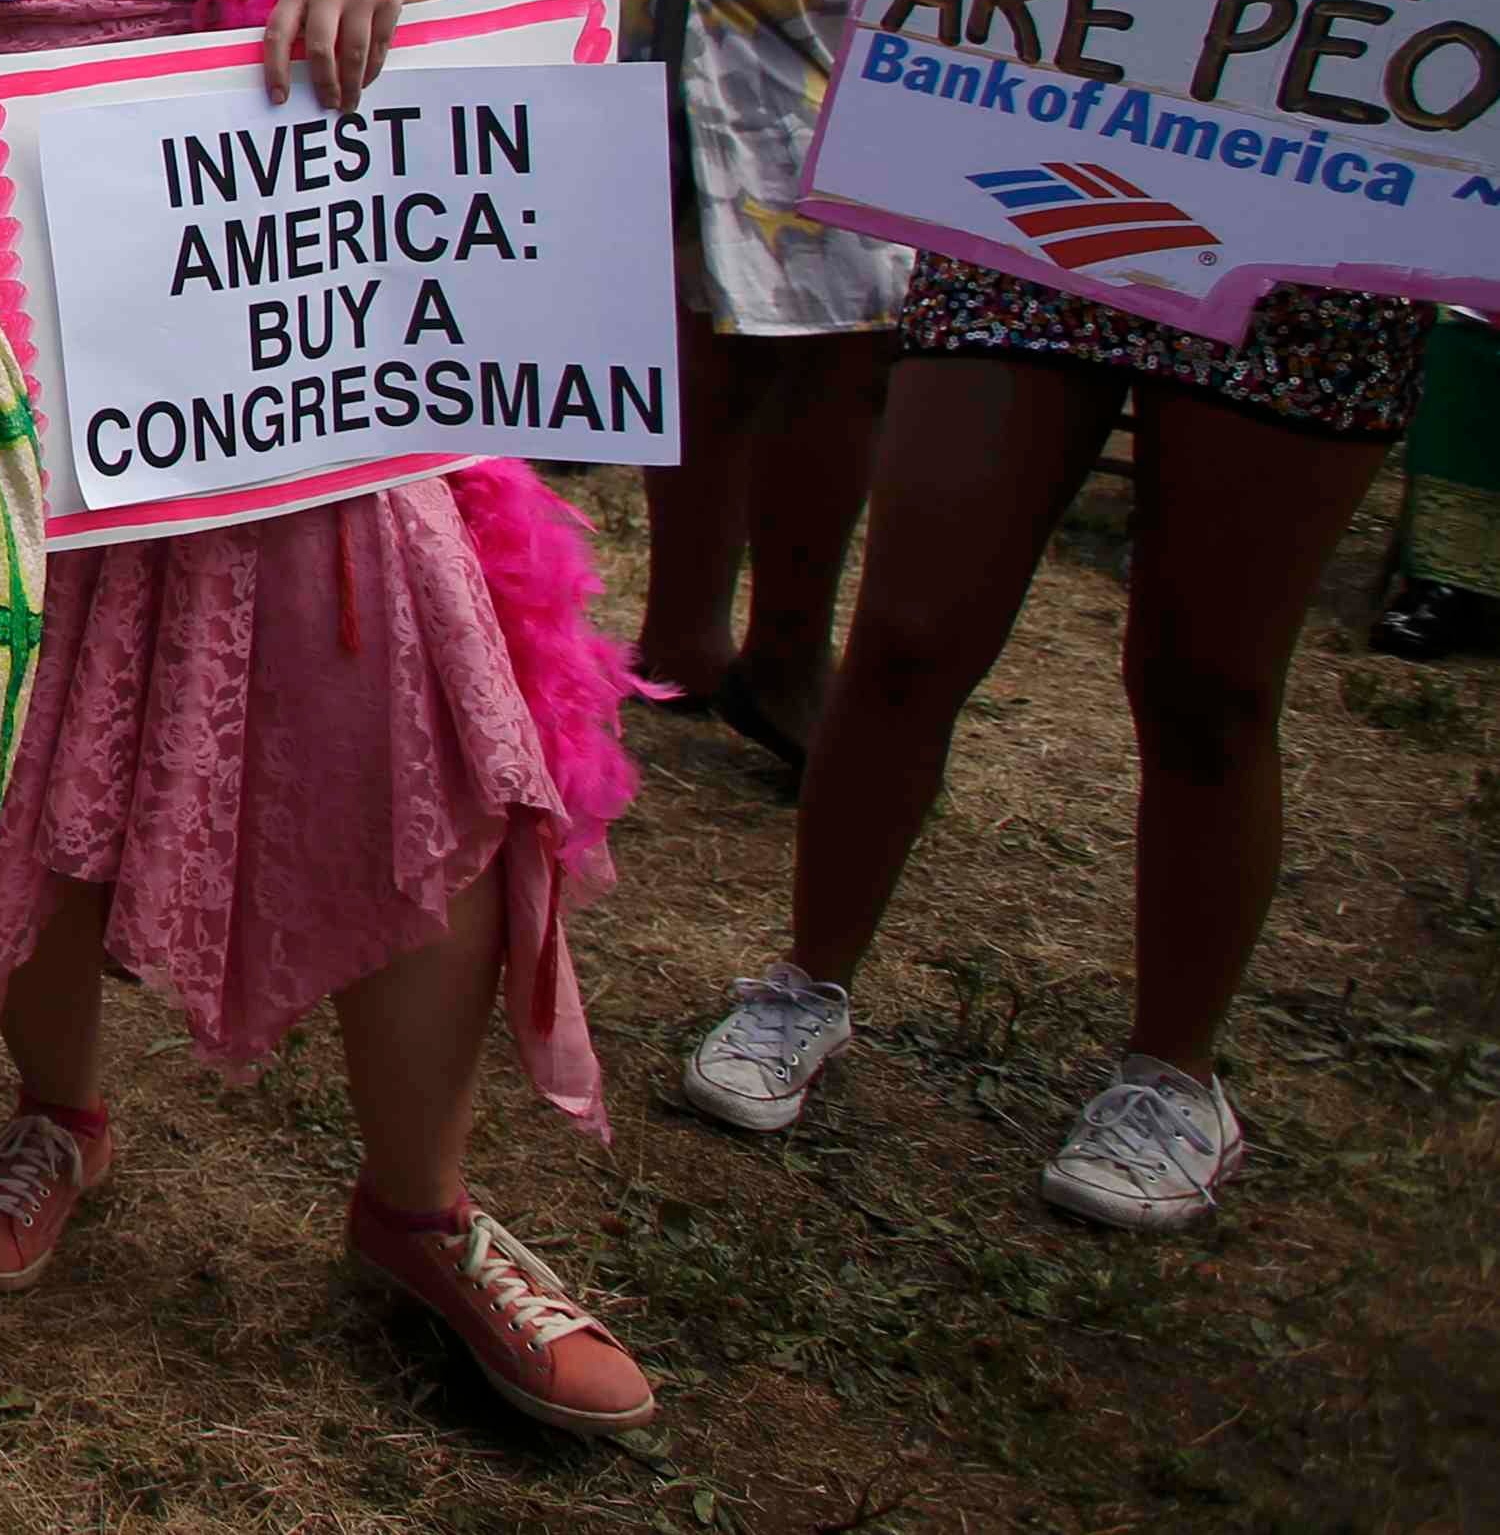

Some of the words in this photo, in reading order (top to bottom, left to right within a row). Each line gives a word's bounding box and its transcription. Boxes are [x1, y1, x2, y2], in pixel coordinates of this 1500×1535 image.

[162, 106, 421, 209] INVEST
[450, 104, 532, 176] IN
[859, 32, 1025, 115] Bank
[1026, 79, 1106, 131] of
[1098, 87, 1416, 207] America
[169, 192, 539, 297] AMERICA:
[248, 279, 382, 372] BUY
[404, 278, 465, 347] A
[86, 359, 665, 478] CONGRESSMAN
